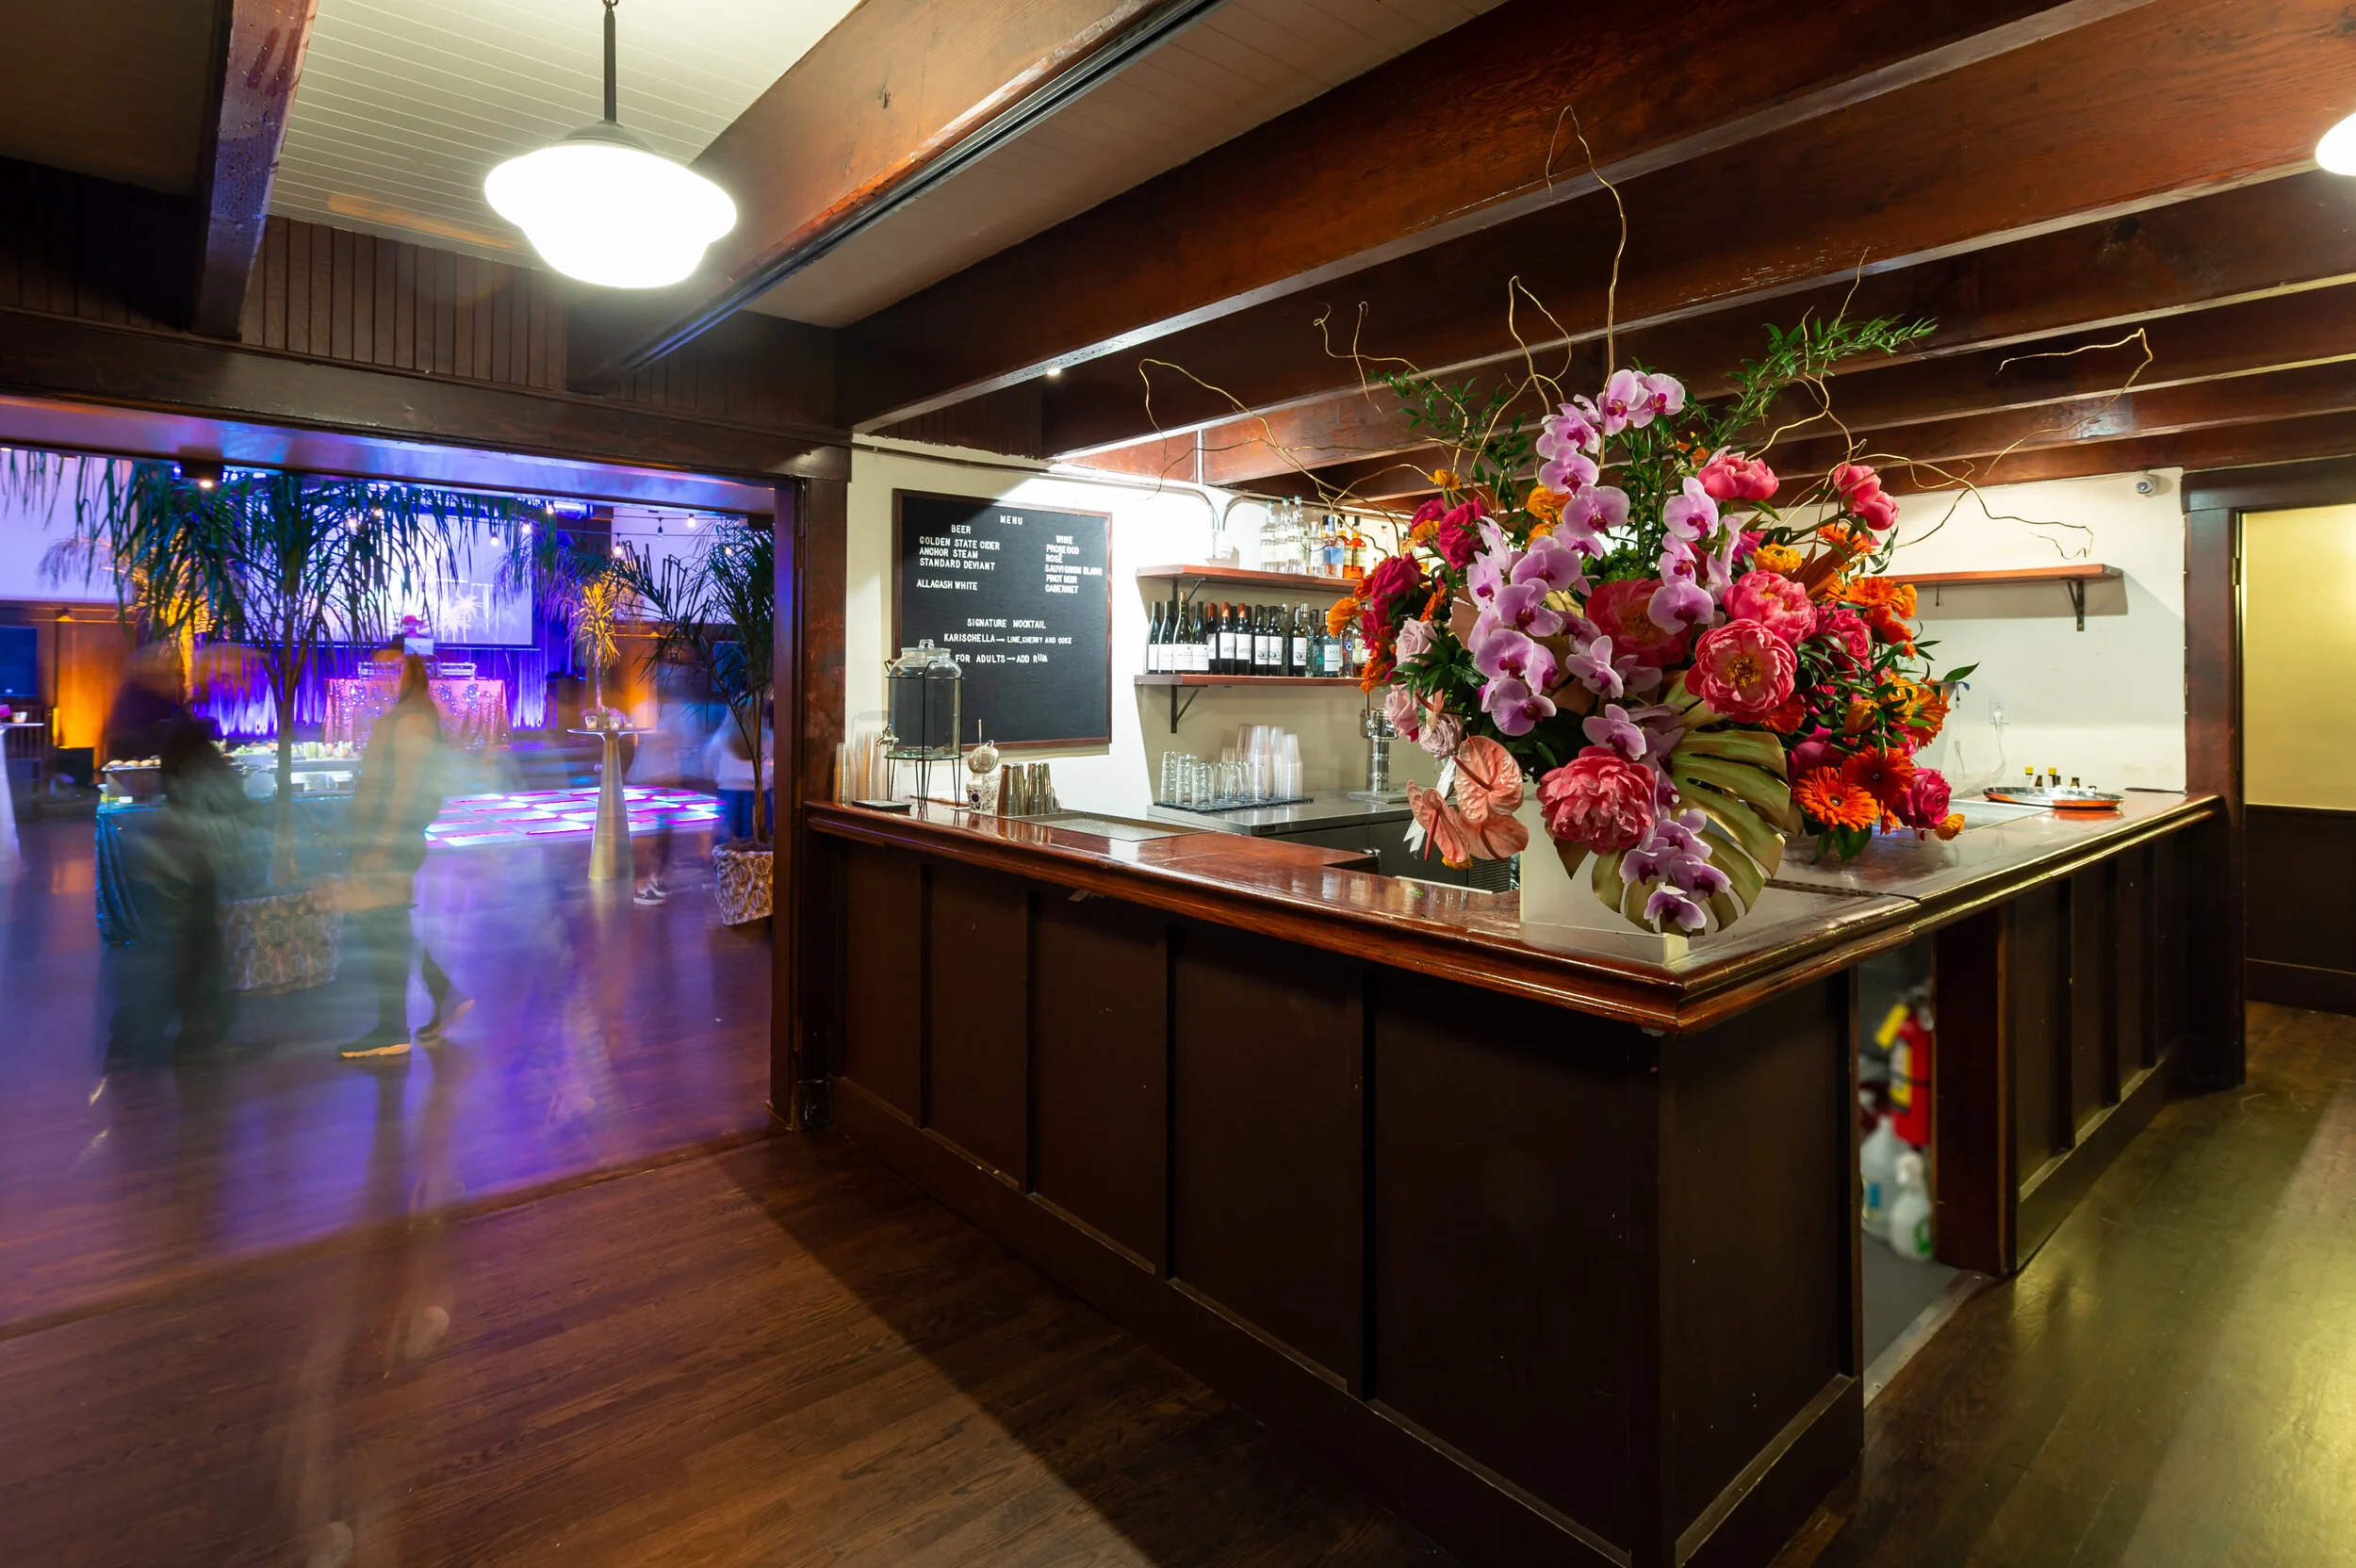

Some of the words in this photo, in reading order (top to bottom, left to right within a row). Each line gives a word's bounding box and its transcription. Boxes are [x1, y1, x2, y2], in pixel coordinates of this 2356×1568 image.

[1000, 514, 1023, 525] MENU
[951, 524, 972, 534] BEER
[919, 535, 951, 547] GOLDEN
[954, 538, 977, 549] STATE
[979, 541, 1000, 550] CIDER
[1055, 535, 1073, 545] WINE
[919, 547, 949, 557] ANCHOR
[953, 548, 978, 559] STEAM
[919, 557, 961, 569] STANDARD
[963, 560, 995, 571] DEVIANT
[1045, 574, 1063, 583] PINOT
[1063, 575, 1078, 584] NOIR
[916, 579, 953, 590] ALLAGASH
[955, 580, 978, 591] WHITE
[1044, 584, 1079, 595] CABERNET
[967, 618, 1007, 628] SIGNATURE
[1012, 619, 1047, 629] MOCKTAIL
[943, 632, 996, 643] KARISCHELLA
[1044, 636, 1056, 645] AND
[955, 653, 971, 662] FOR
[975, 654, 1006, 663] ADULTS
[1016, 654, 1030, 663] ADD
[1032, 653, 1049, 662] RUM
